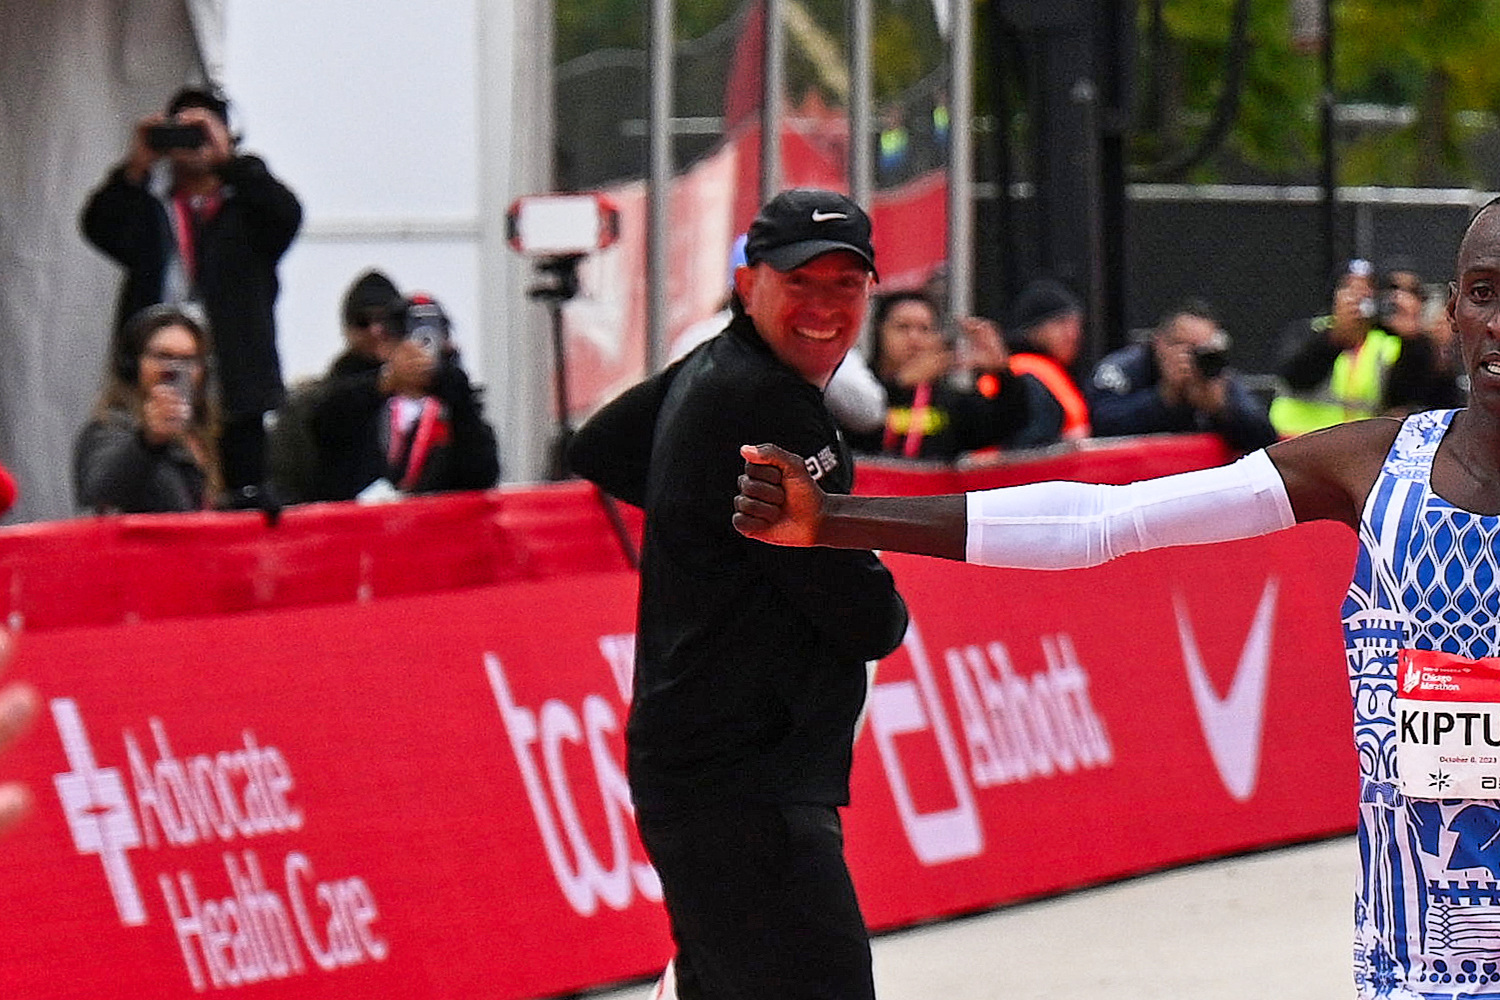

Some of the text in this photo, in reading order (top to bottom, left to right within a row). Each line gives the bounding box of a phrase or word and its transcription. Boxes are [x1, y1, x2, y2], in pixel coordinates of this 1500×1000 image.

[946, 632, 1112, 788] Abbott
[123, 716, 304, 850] Advocate
[158, 849, 388, 993] Health Care
